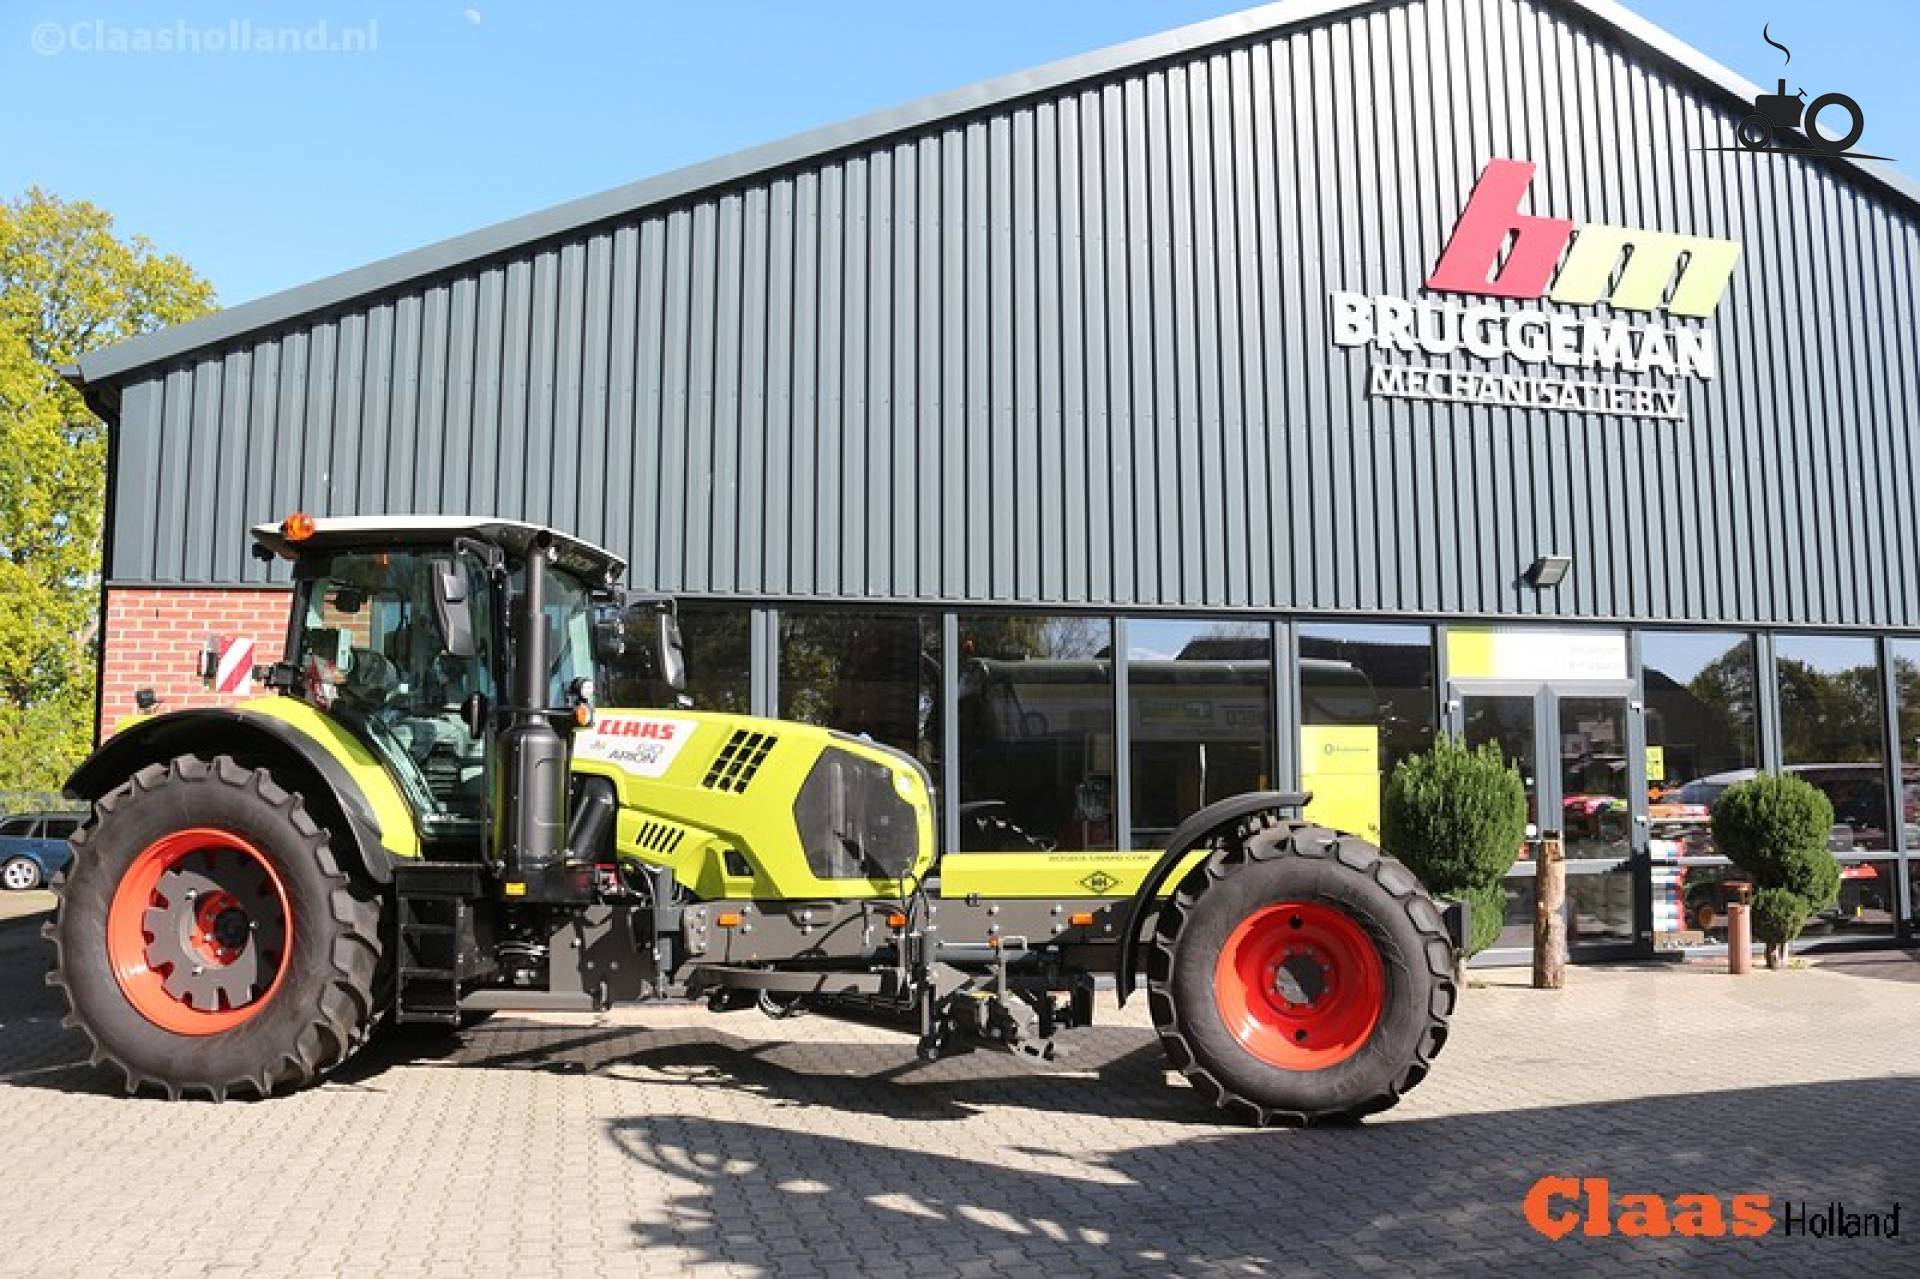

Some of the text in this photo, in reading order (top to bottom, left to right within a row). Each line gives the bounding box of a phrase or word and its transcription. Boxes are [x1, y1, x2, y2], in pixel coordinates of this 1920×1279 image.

[1332, 291, 1714, 378] BRUGGEMAN
[1370, 364, 1632, 414] MECHANISATIE
[597, 719, 675, 740] CLAAS
